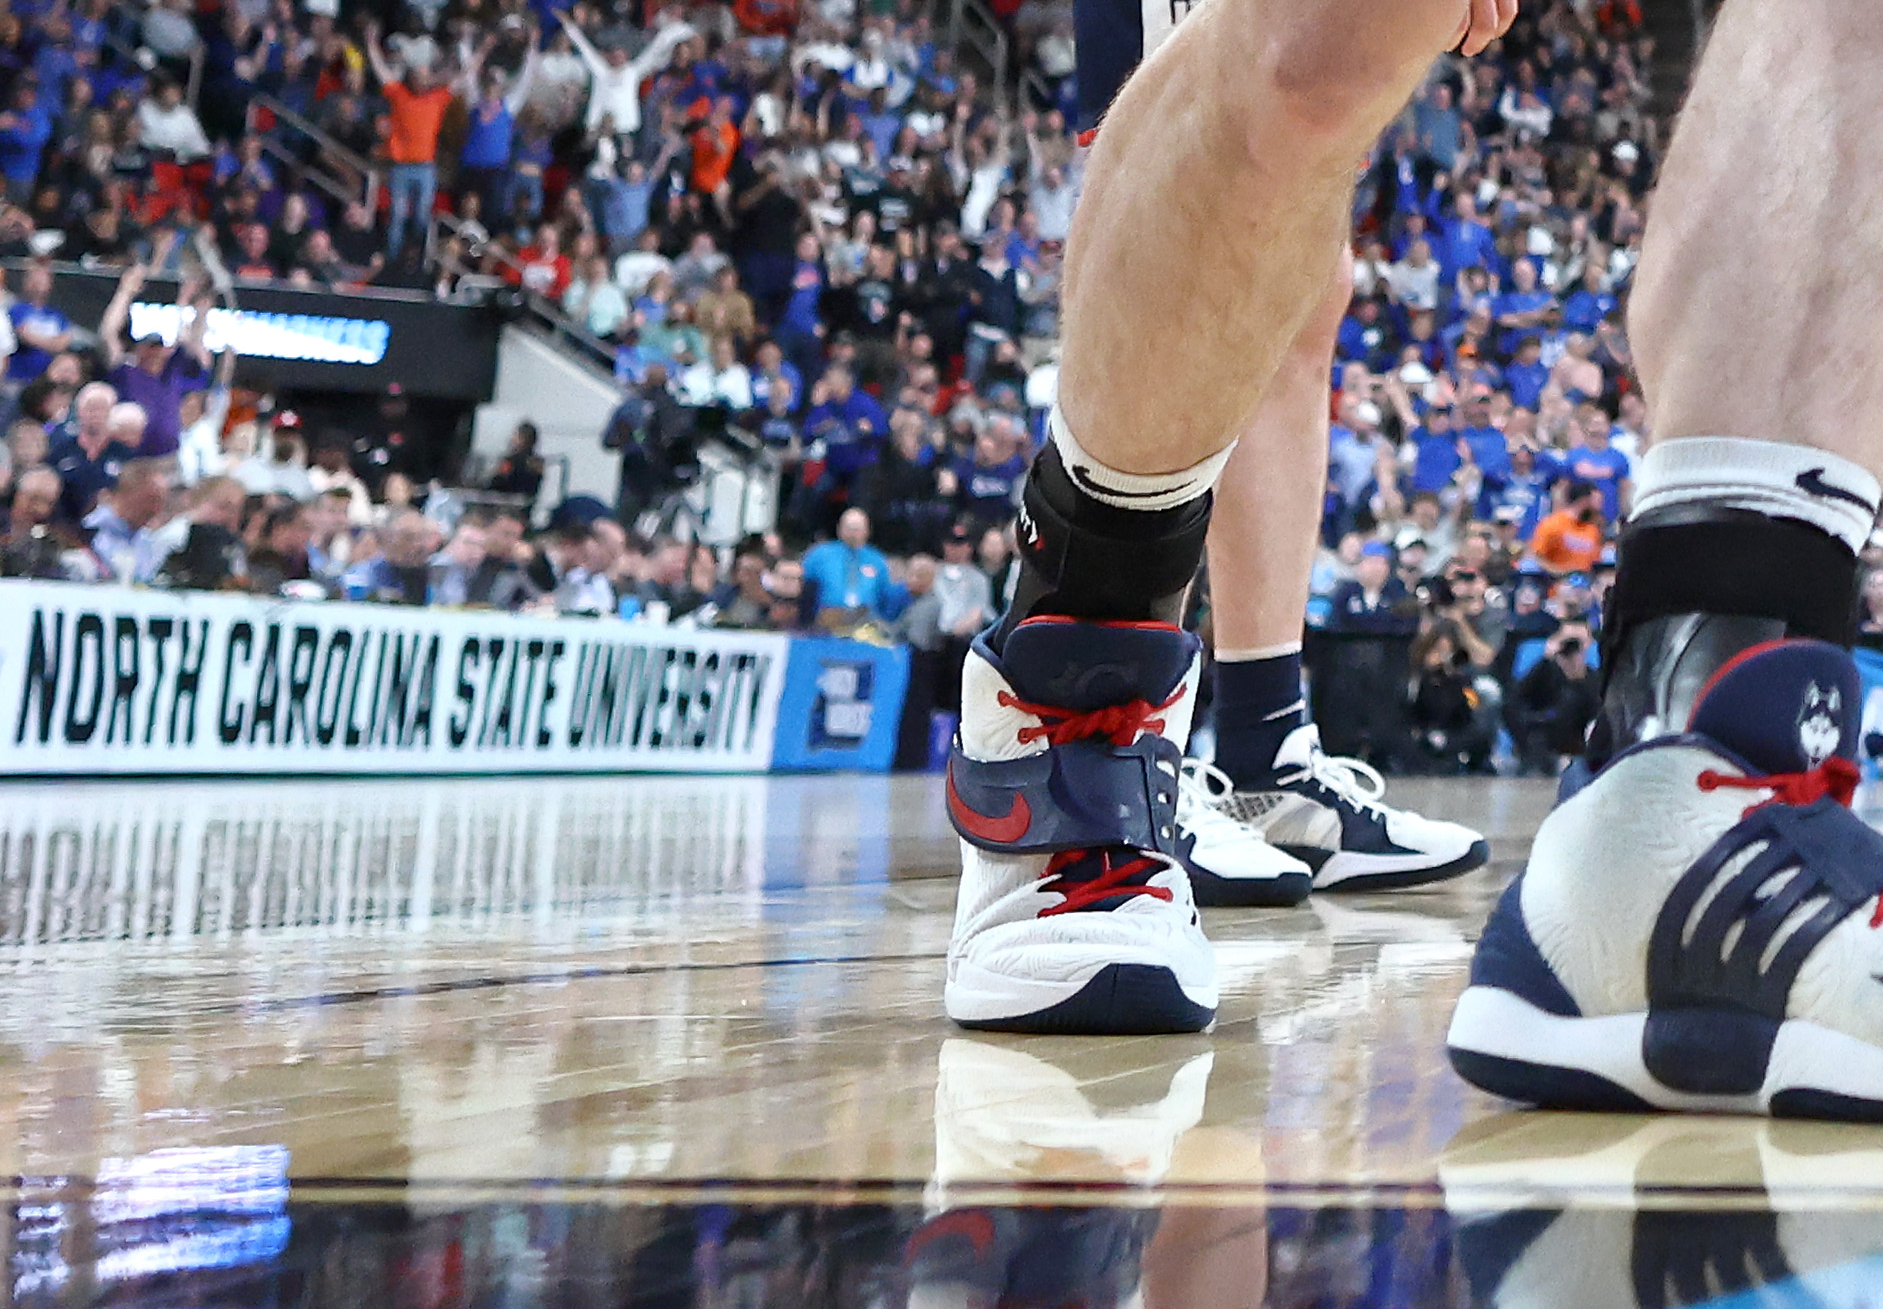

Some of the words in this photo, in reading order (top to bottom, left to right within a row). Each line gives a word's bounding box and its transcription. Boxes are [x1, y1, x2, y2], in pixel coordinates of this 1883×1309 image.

[15, 609, 207, 747] NORTH
[215, 621, 440, 747] CAROLINA
[450, 635, 564, 747] STATE
[567, 641, 772, 750] UNIVERSITY
